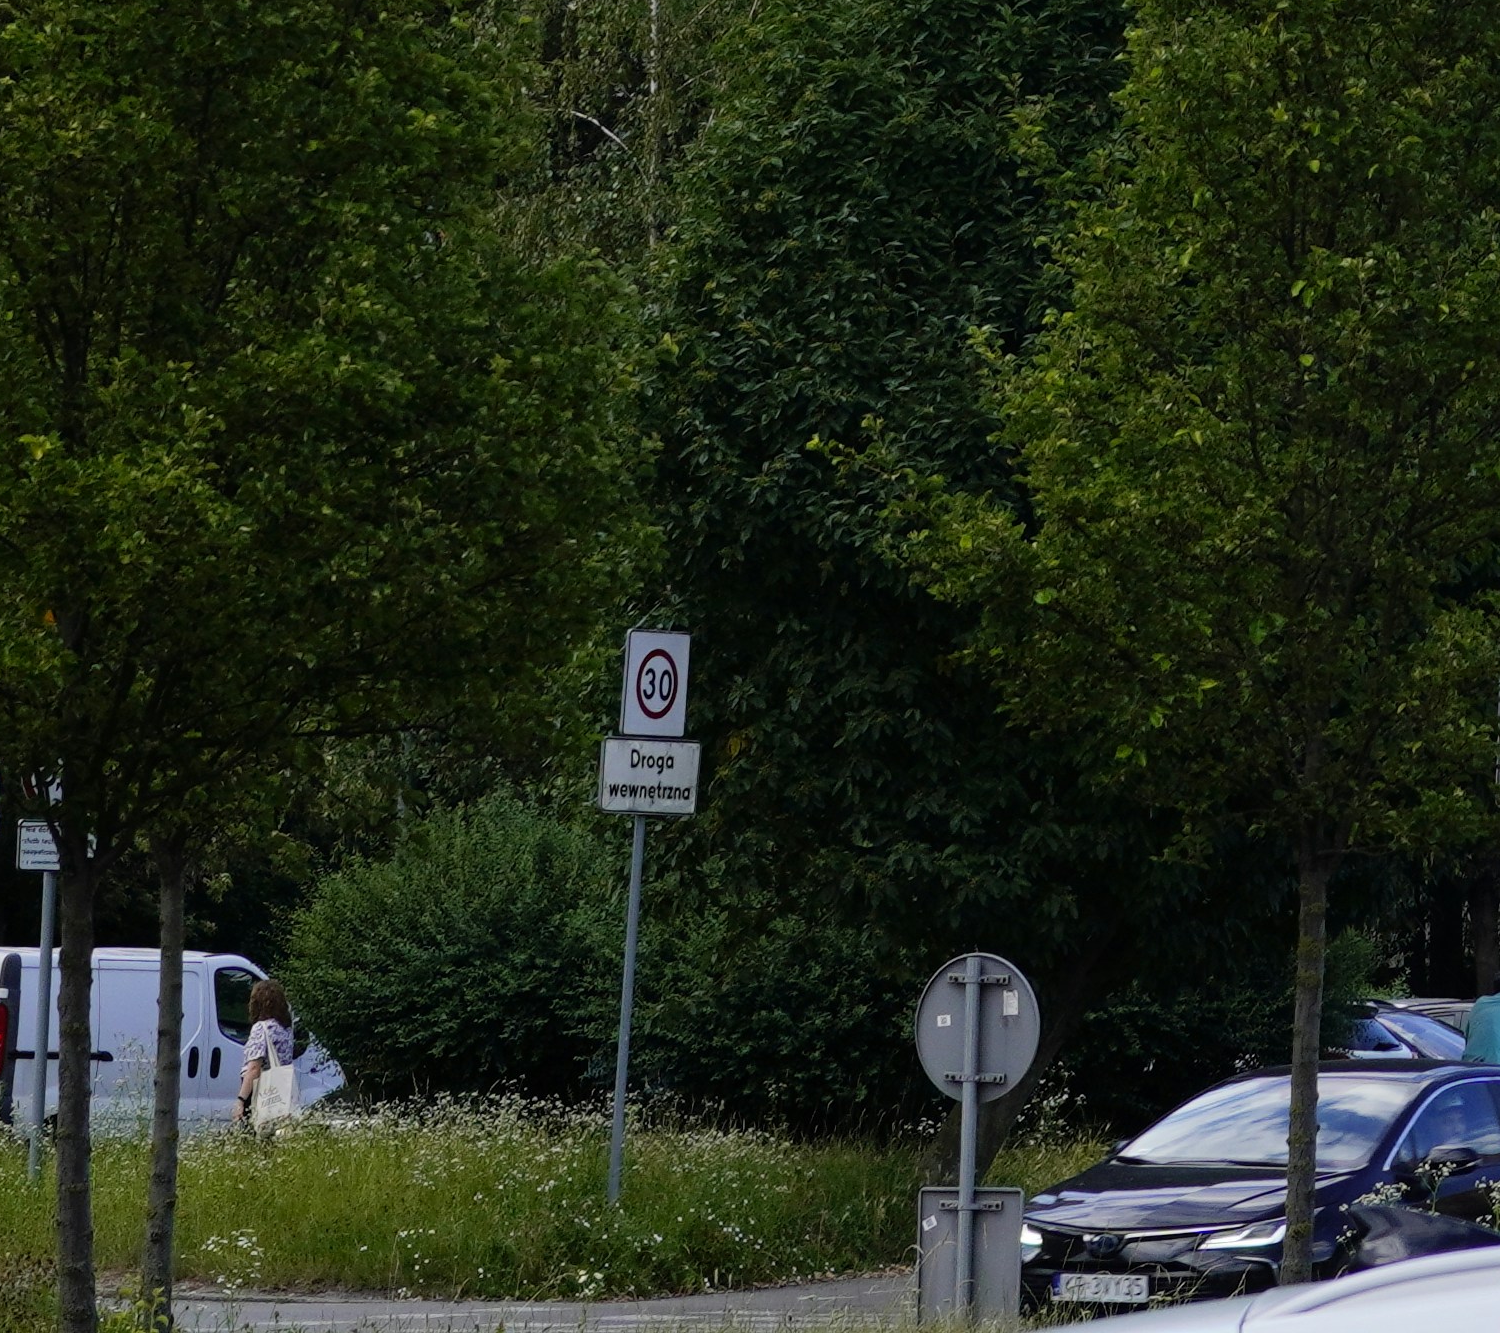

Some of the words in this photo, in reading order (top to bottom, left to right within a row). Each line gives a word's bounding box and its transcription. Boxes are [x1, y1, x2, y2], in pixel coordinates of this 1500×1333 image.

[643, 668, 672, 701] 30
[630, 749, 674, 774] Droga
[609, 782, 691, 804] wewnętrzna
